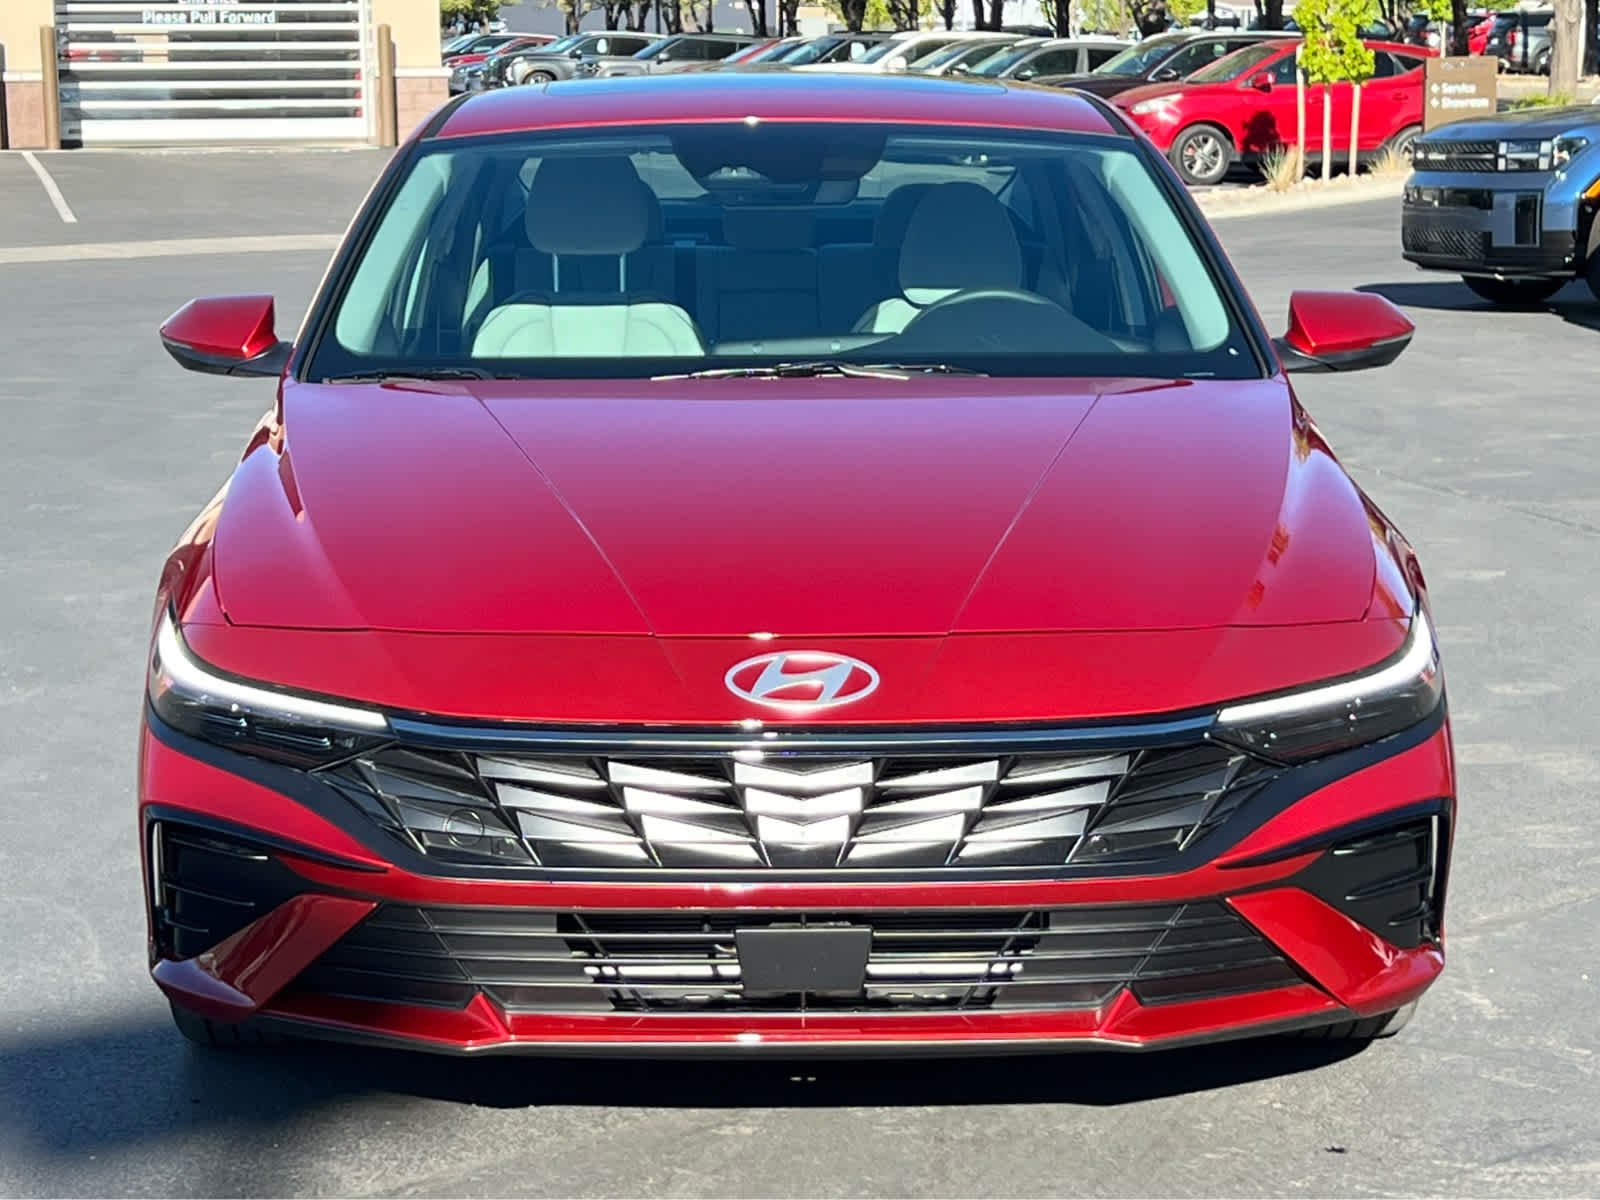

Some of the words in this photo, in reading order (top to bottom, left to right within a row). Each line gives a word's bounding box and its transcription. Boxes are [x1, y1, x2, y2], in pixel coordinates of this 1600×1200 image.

[143, 10, 187, 24] Please
[190, 10, 216, 24] Pull
[220, 10, 276, 24] Forward
